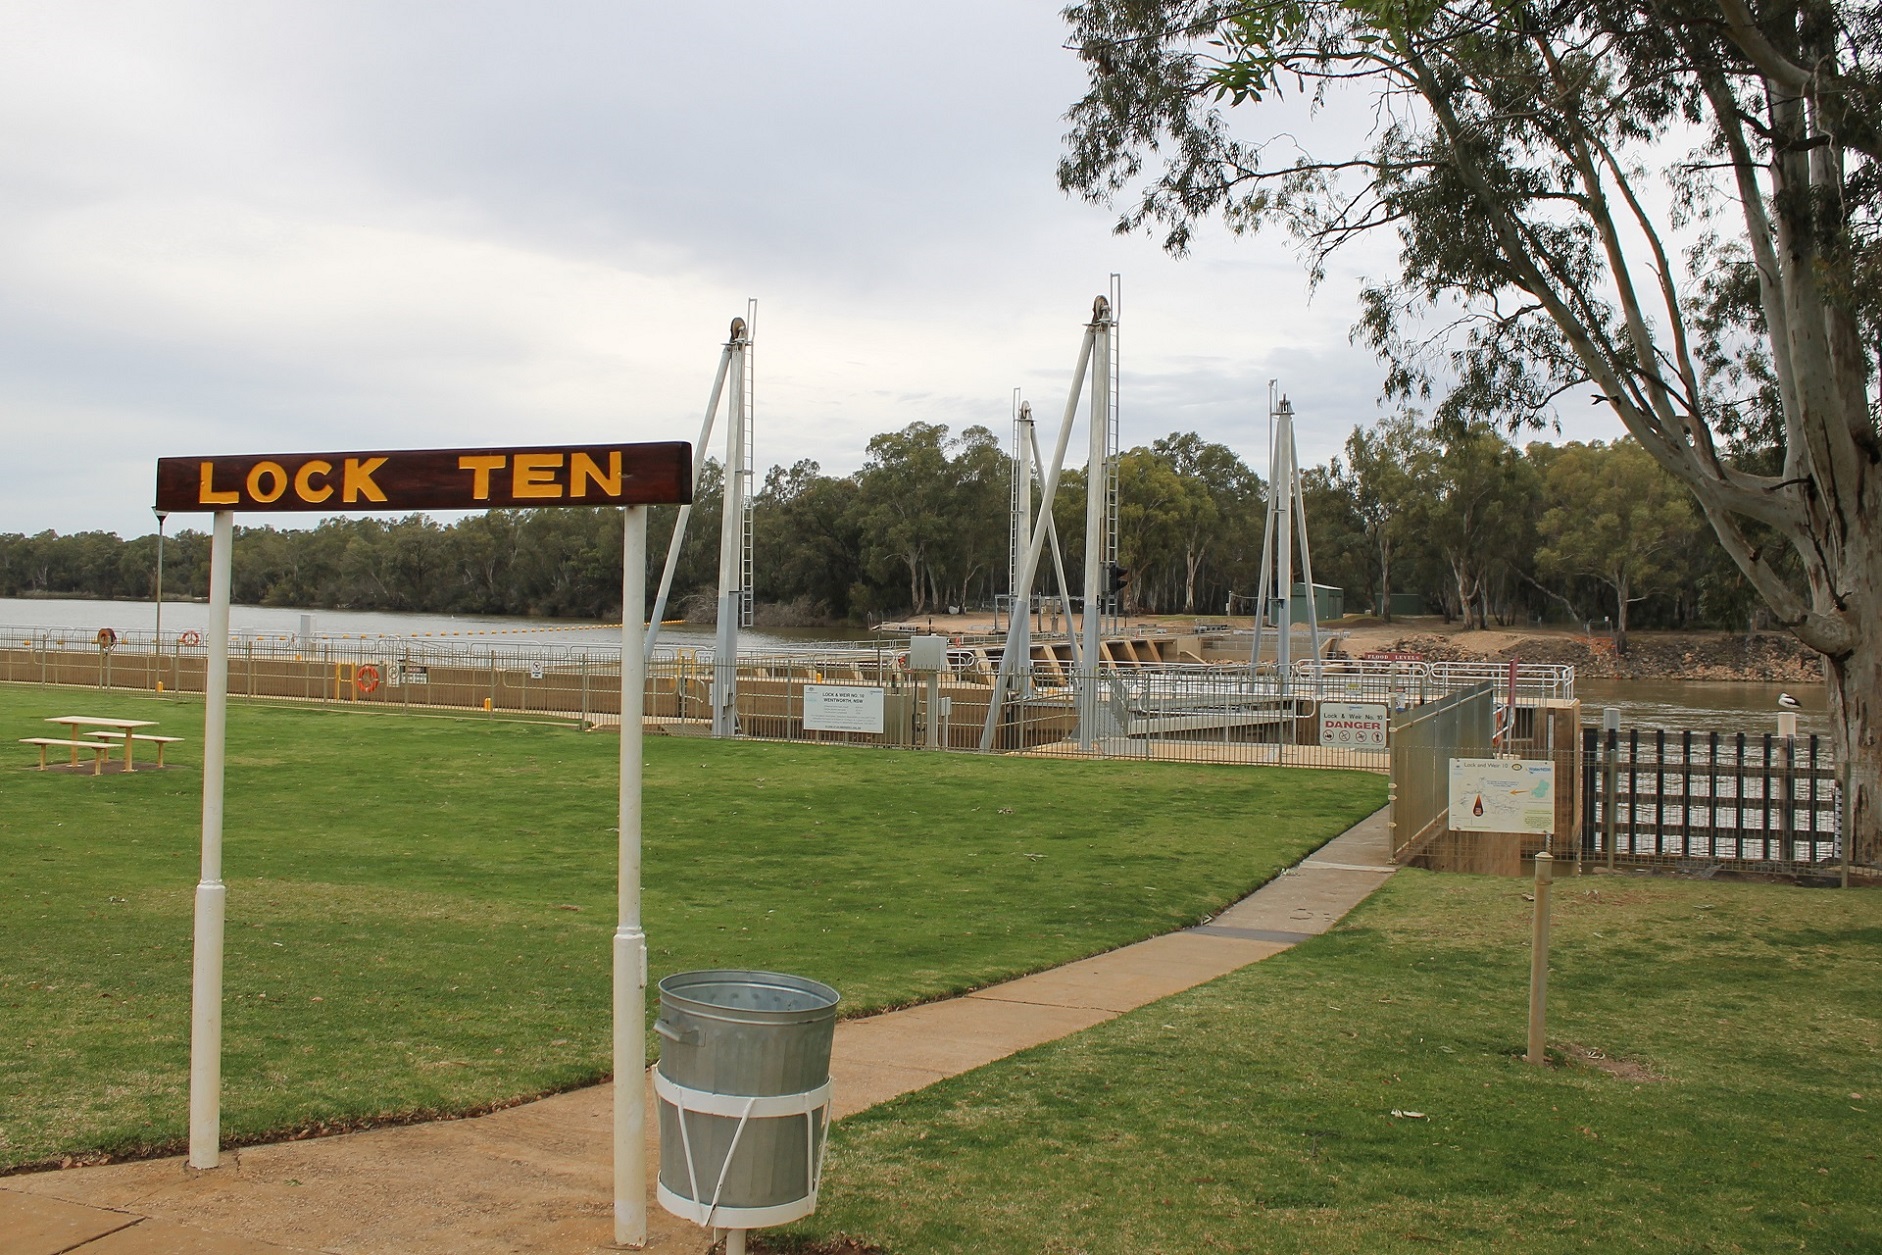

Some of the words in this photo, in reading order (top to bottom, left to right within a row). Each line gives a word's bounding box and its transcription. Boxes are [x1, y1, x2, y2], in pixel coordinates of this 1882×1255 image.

[198, 456, 389, 505] LOCK
[458, 451, 622, 498] TEN
[1325, 720, 1381, 730] DANGER
